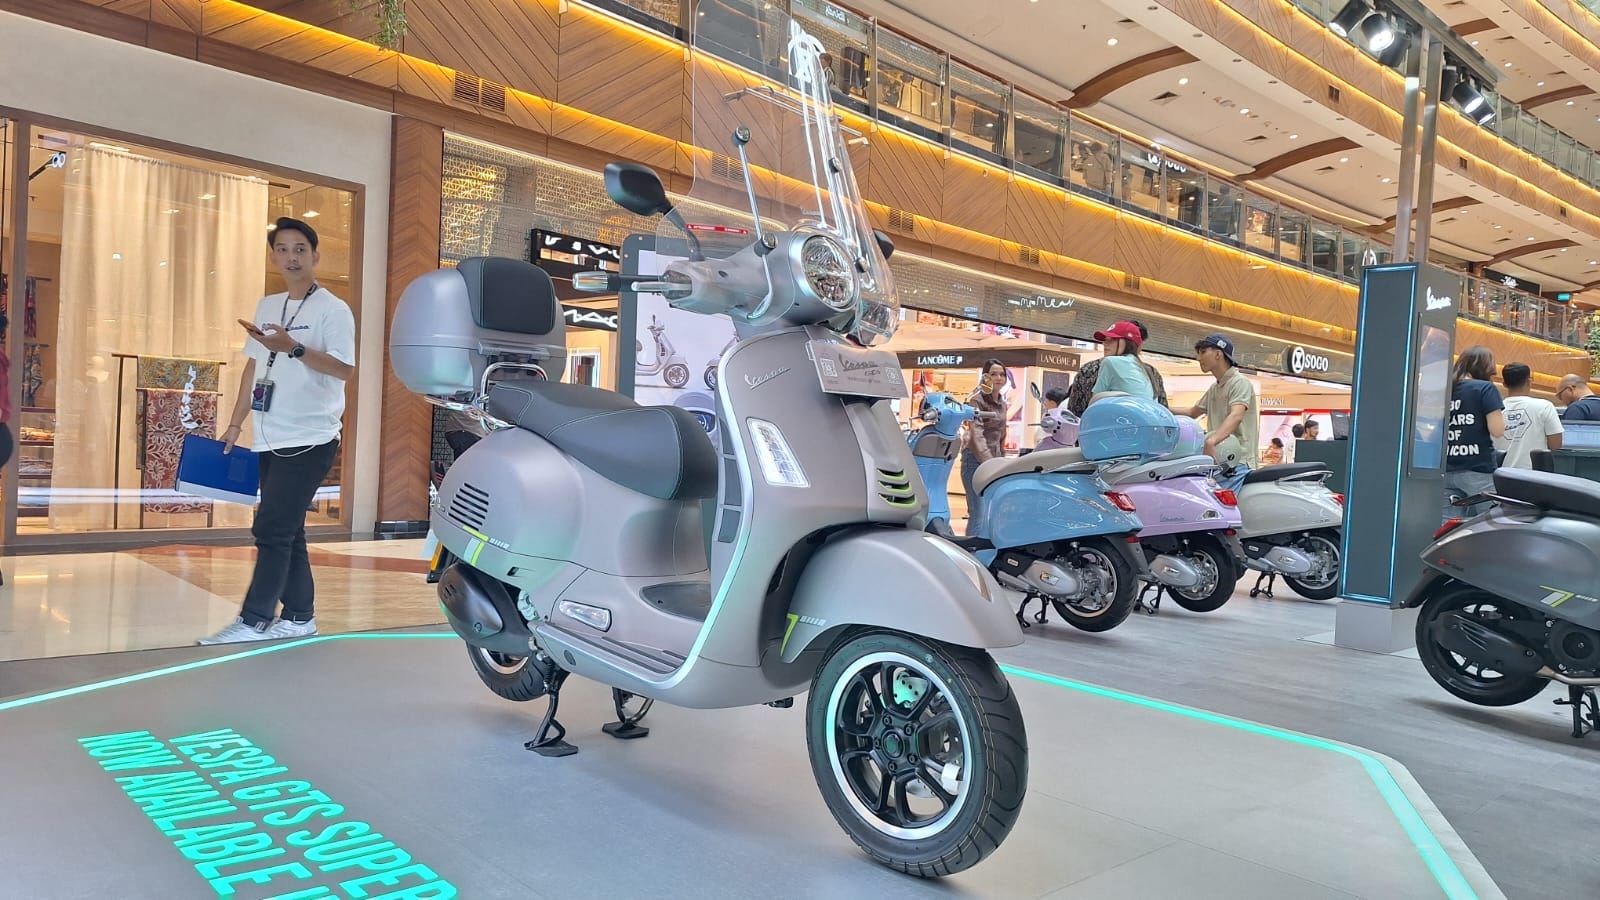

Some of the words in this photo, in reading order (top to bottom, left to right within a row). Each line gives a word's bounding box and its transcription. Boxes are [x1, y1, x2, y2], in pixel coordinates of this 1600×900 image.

[918, 355, 955, 365] LANCÔME
[1041, 354, 1070, 365] LANCÔME
[1305, 354, 1328, 371] SOGO
[744, 368, 791, 390] Vespa
[1449, 414, 1475, 426] ARS
[1448, 430, 1462, 440] OF
[77, 730, 184, 771] NOW
[168, 728, 288, 785] VESPA
[233, 780, 344, 826] GTS
[113, 770, 313, 896] AVAILABLE
